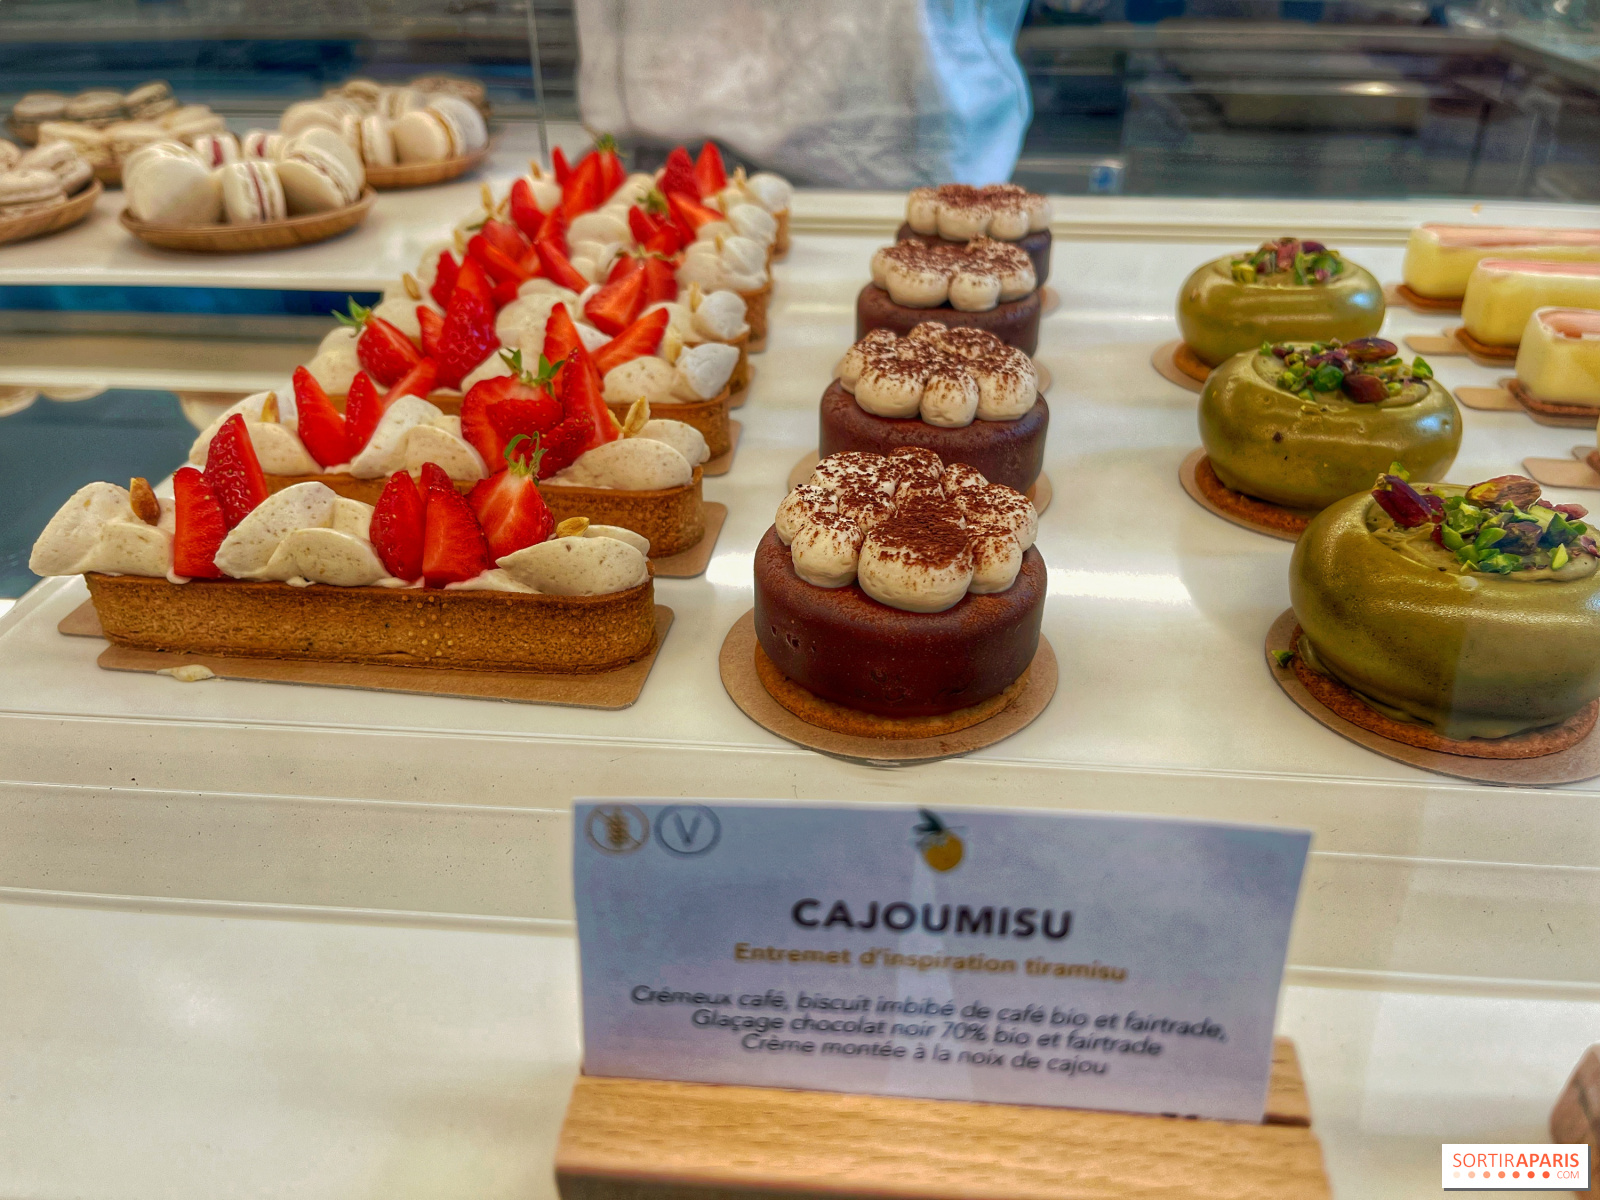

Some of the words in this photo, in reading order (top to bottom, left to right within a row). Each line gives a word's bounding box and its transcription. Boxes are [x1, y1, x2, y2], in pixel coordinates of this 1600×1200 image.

[791, 898, 1074, 940] CAJOUMISU
[733, 942, 851, 966] Entremet
[858, 948, 1016, 974] d'inspiration
[1025, 956, 1128, 983] tiramisu
[630, 984, 732, 1007] Crémeux
[737, 989, 790, 1012] café,
[796, 991, 871, 1013] biscuit
[876, 995, 954, 1018] imbibé
[960, 999, 991, 1021] de
[996, 1002, 1045, 1024] café
[1049, 1004, 1088, 1027] bio
[1094, 1011, 1119, 1029] et
[1124, 1010, 1229, 1042] fairtrade,
[691, 1008, 786, 1033] Glaçage
[790, 1014, 886, 1035] chocolat
[890, 1018, 936, 1038] noir
[941, 1020, 987, 1043] 70%
[993, 1025, 1032, 1047] bio
[1036, 1031, 1062, 1049] et
[1066, 1030, 1163, 1056] fairtrade
[741, 1032, 816, 1054] Crème
[821, 1036, 907, 1058] montée
[912, 1041, 926, 1061] à
[932, 1043, 953, 1062] la
[958, 1047, 1006, 1067] noix
[1010, 1050, 1042, 1071] de
[1046, 1054, 1110, 1078] cajou
